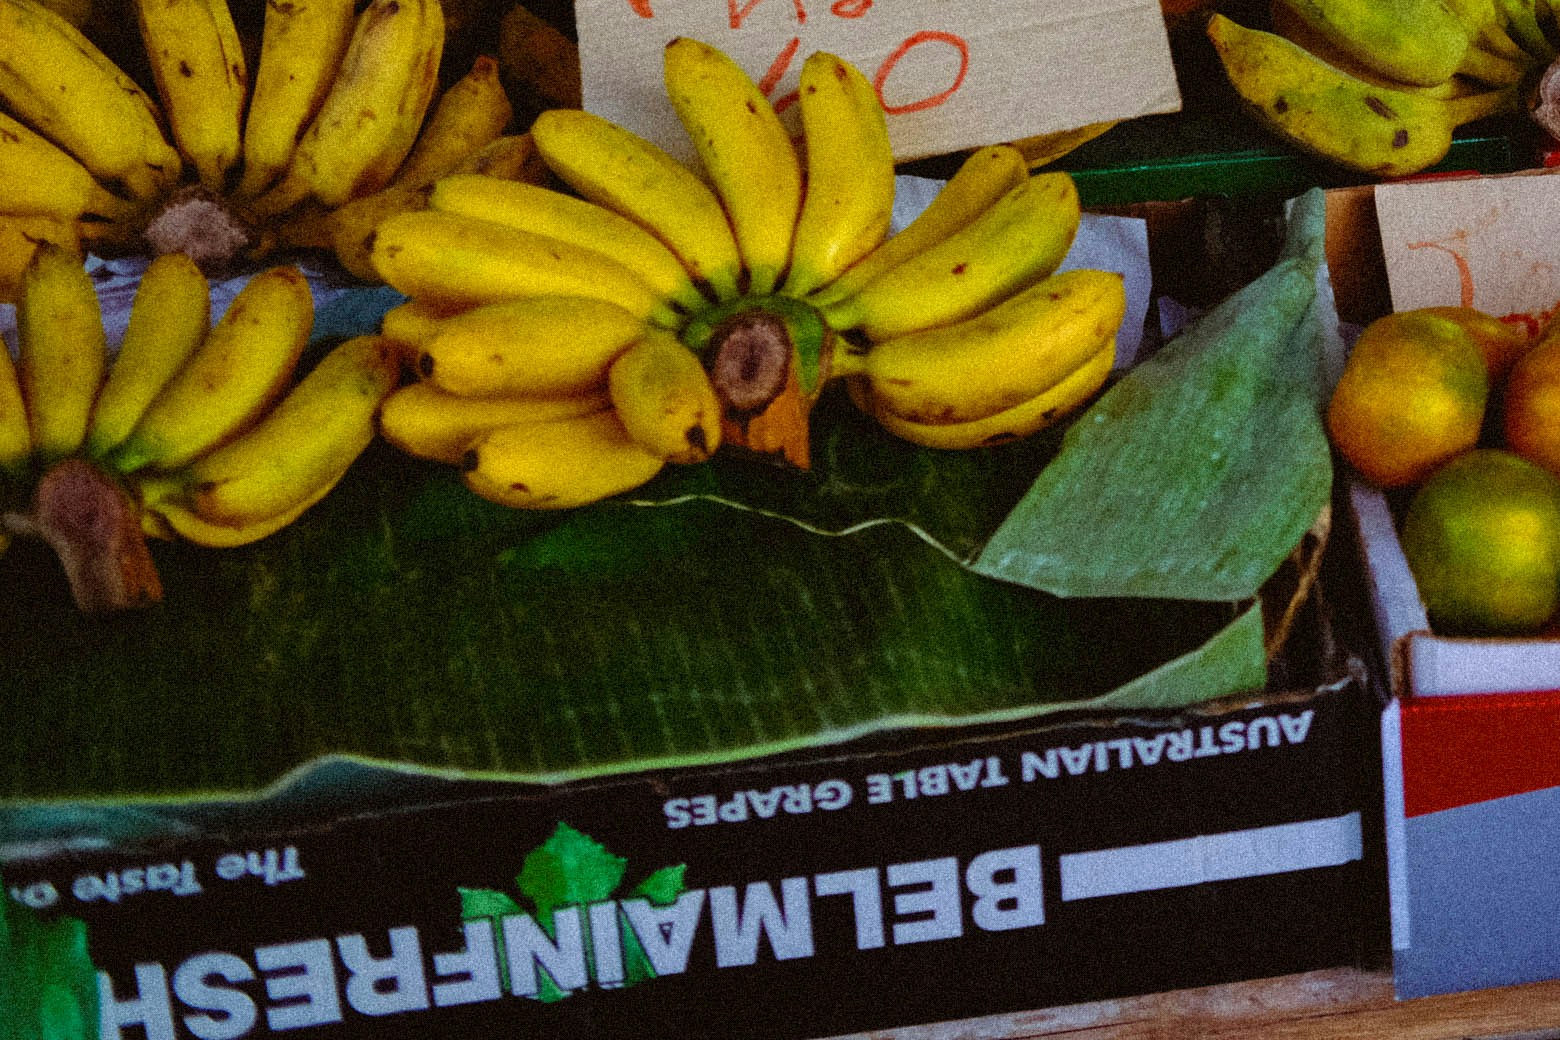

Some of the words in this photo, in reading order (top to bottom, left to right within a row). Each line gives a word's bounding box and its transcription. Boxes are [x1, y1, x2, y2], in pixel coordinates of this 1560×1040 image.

[1019, 709, 1315, 785] AUSTRALIAN
[661, 777, 855, 830] GRAPES
[865, 756, 1010, 805] TABLE
[70, 858, 204, 904] Taste
[214, 846, 306, 887] The
[97, 843, 1047, 1040] BELMAINFRESH
